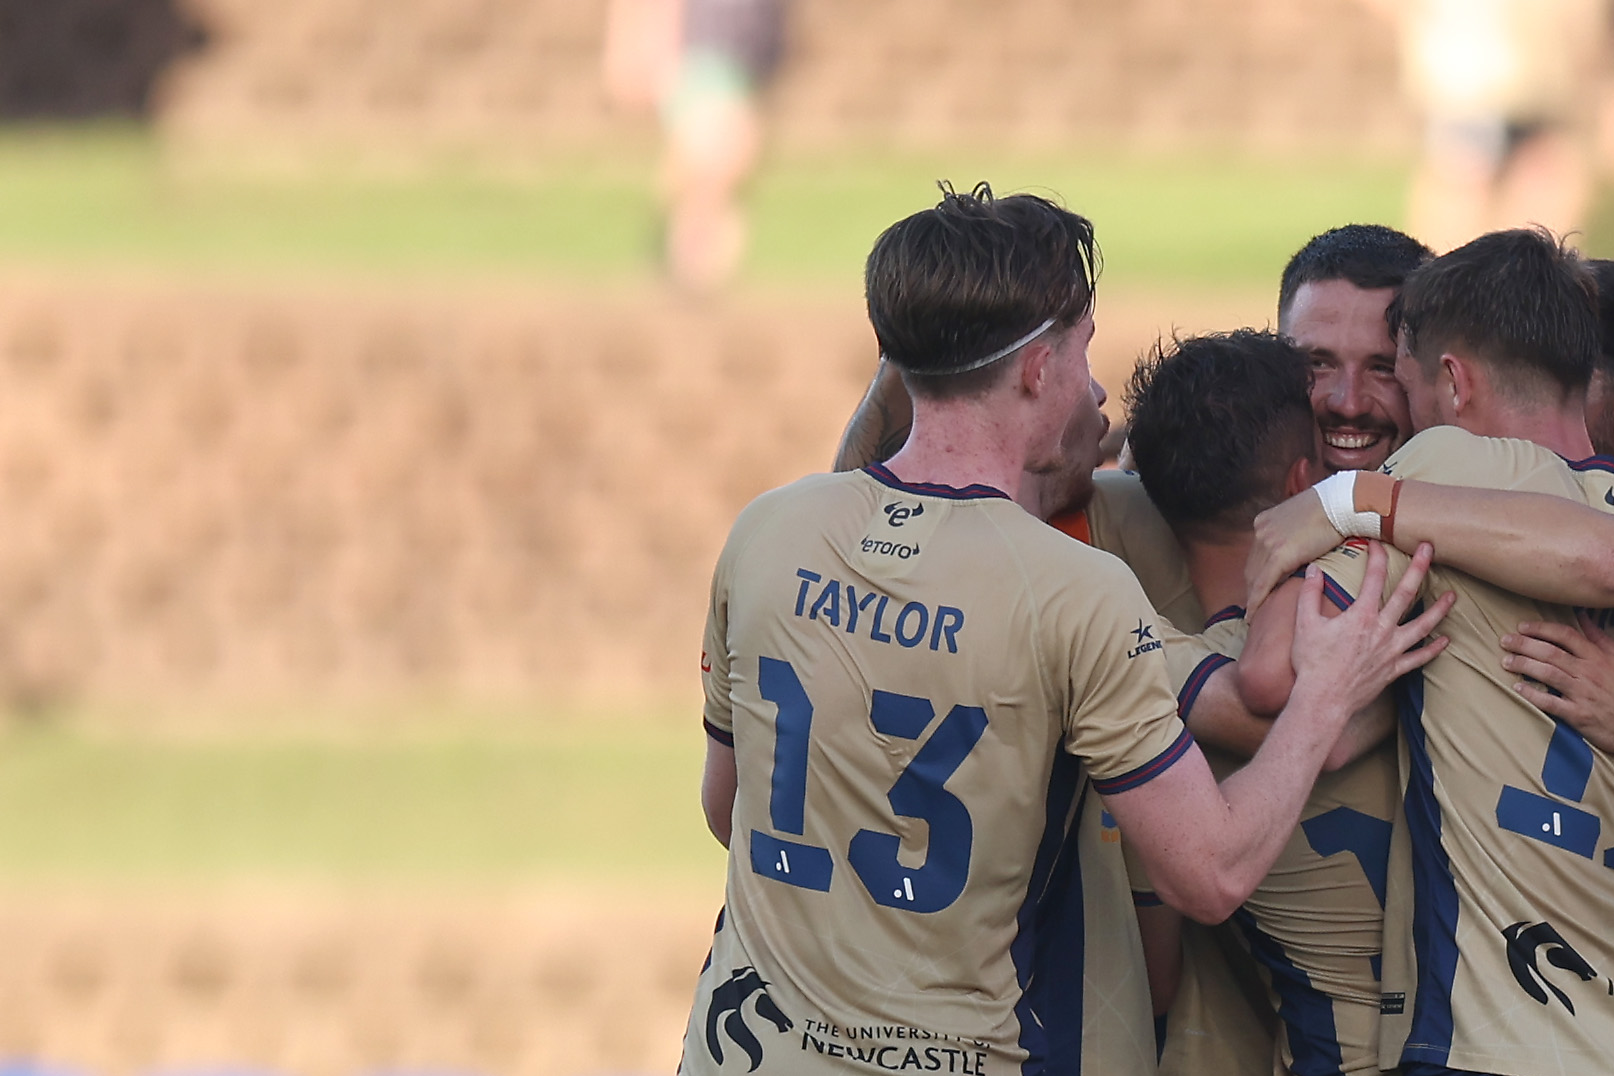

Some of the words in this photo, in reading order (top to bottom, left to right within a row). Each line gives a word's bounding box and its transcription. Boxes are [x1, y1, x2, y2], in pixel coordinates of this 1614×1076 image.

[795, 568, 965, 654] TAYLOR
[750, 655, 989, 914] 13
[802, 1031, 987, 1076] NEWCASTLE
[805, 1019, 840, 1038] THE
